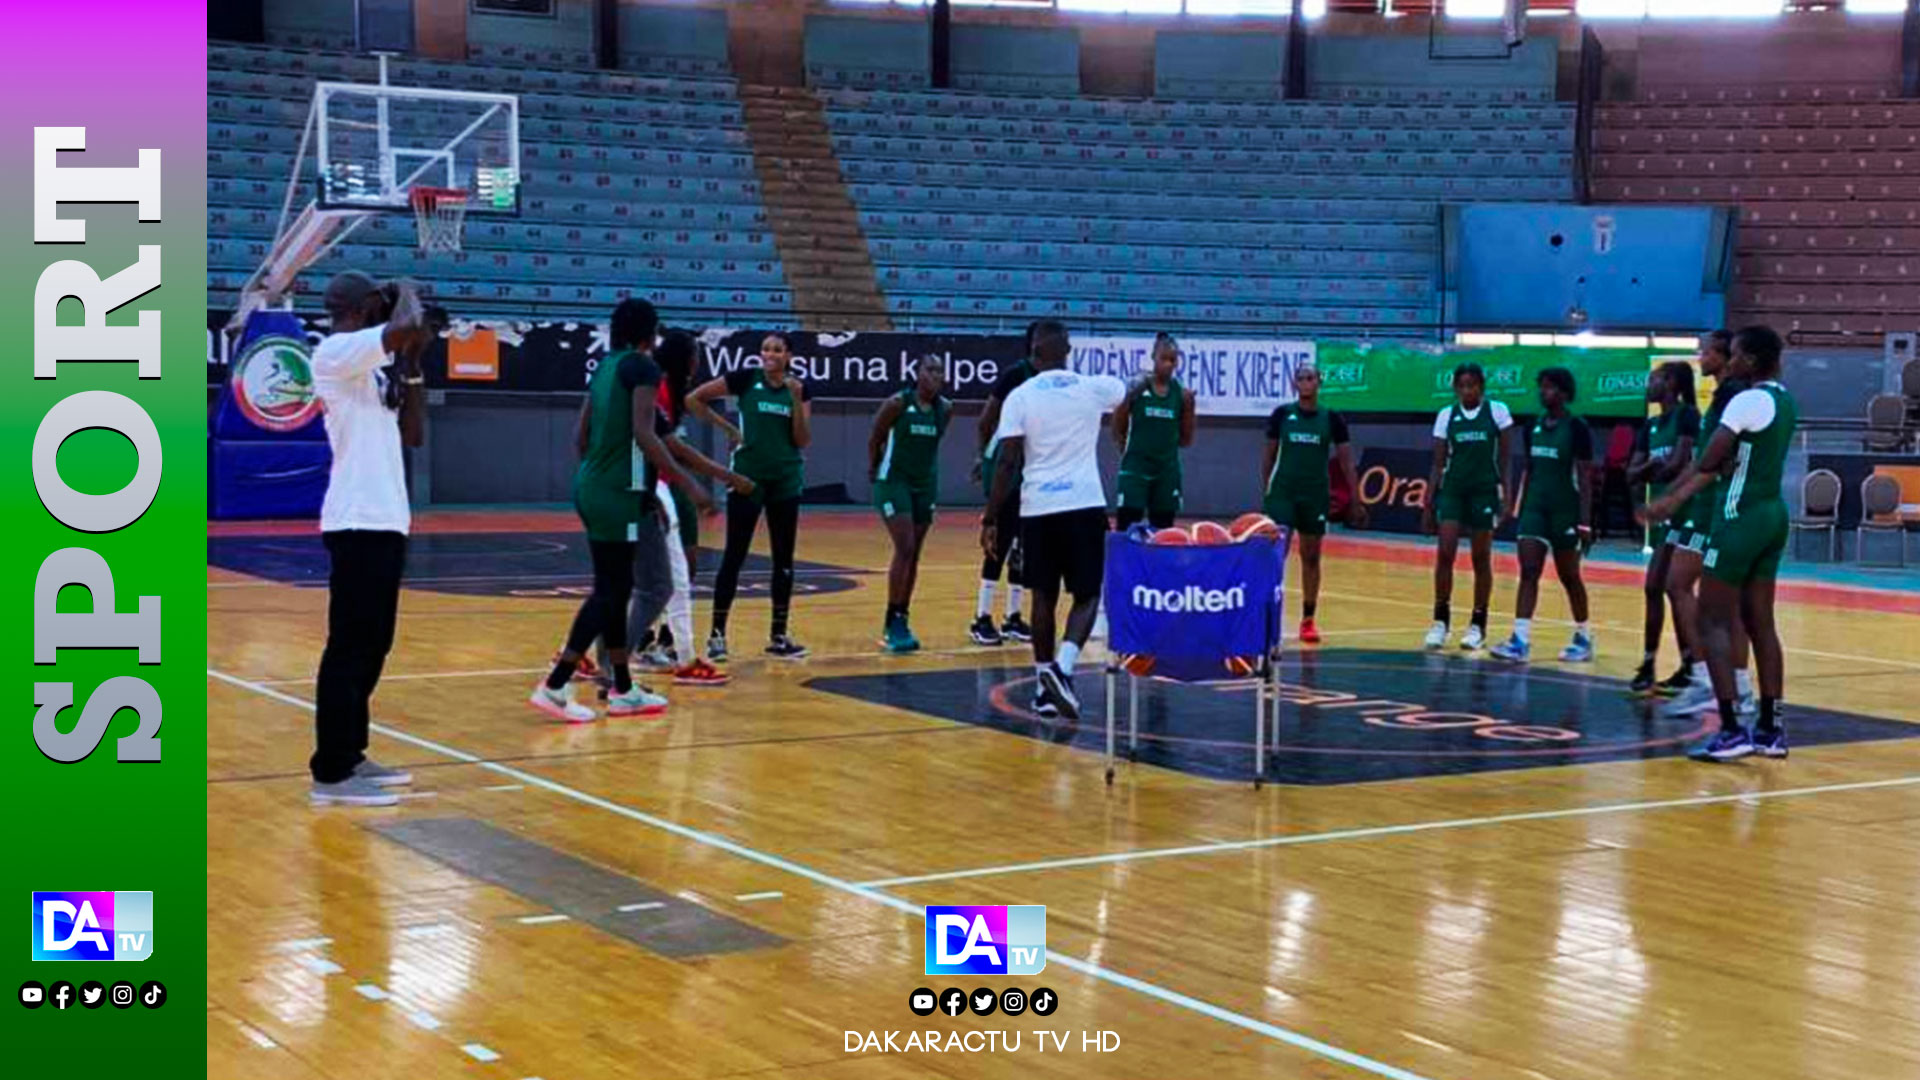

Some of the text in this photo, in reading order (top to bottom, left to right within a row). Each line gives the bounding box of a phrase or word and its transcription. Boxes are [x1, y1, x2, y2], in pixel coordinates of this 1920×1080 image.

[844, 353, 889, 381] na
[902, 350, 998, 390] klpe
[1174, 345, 1228, 397] RÈNE
[1358, 466, 1429, 508] Ora
[1132, 584, 1245, 613] molten
